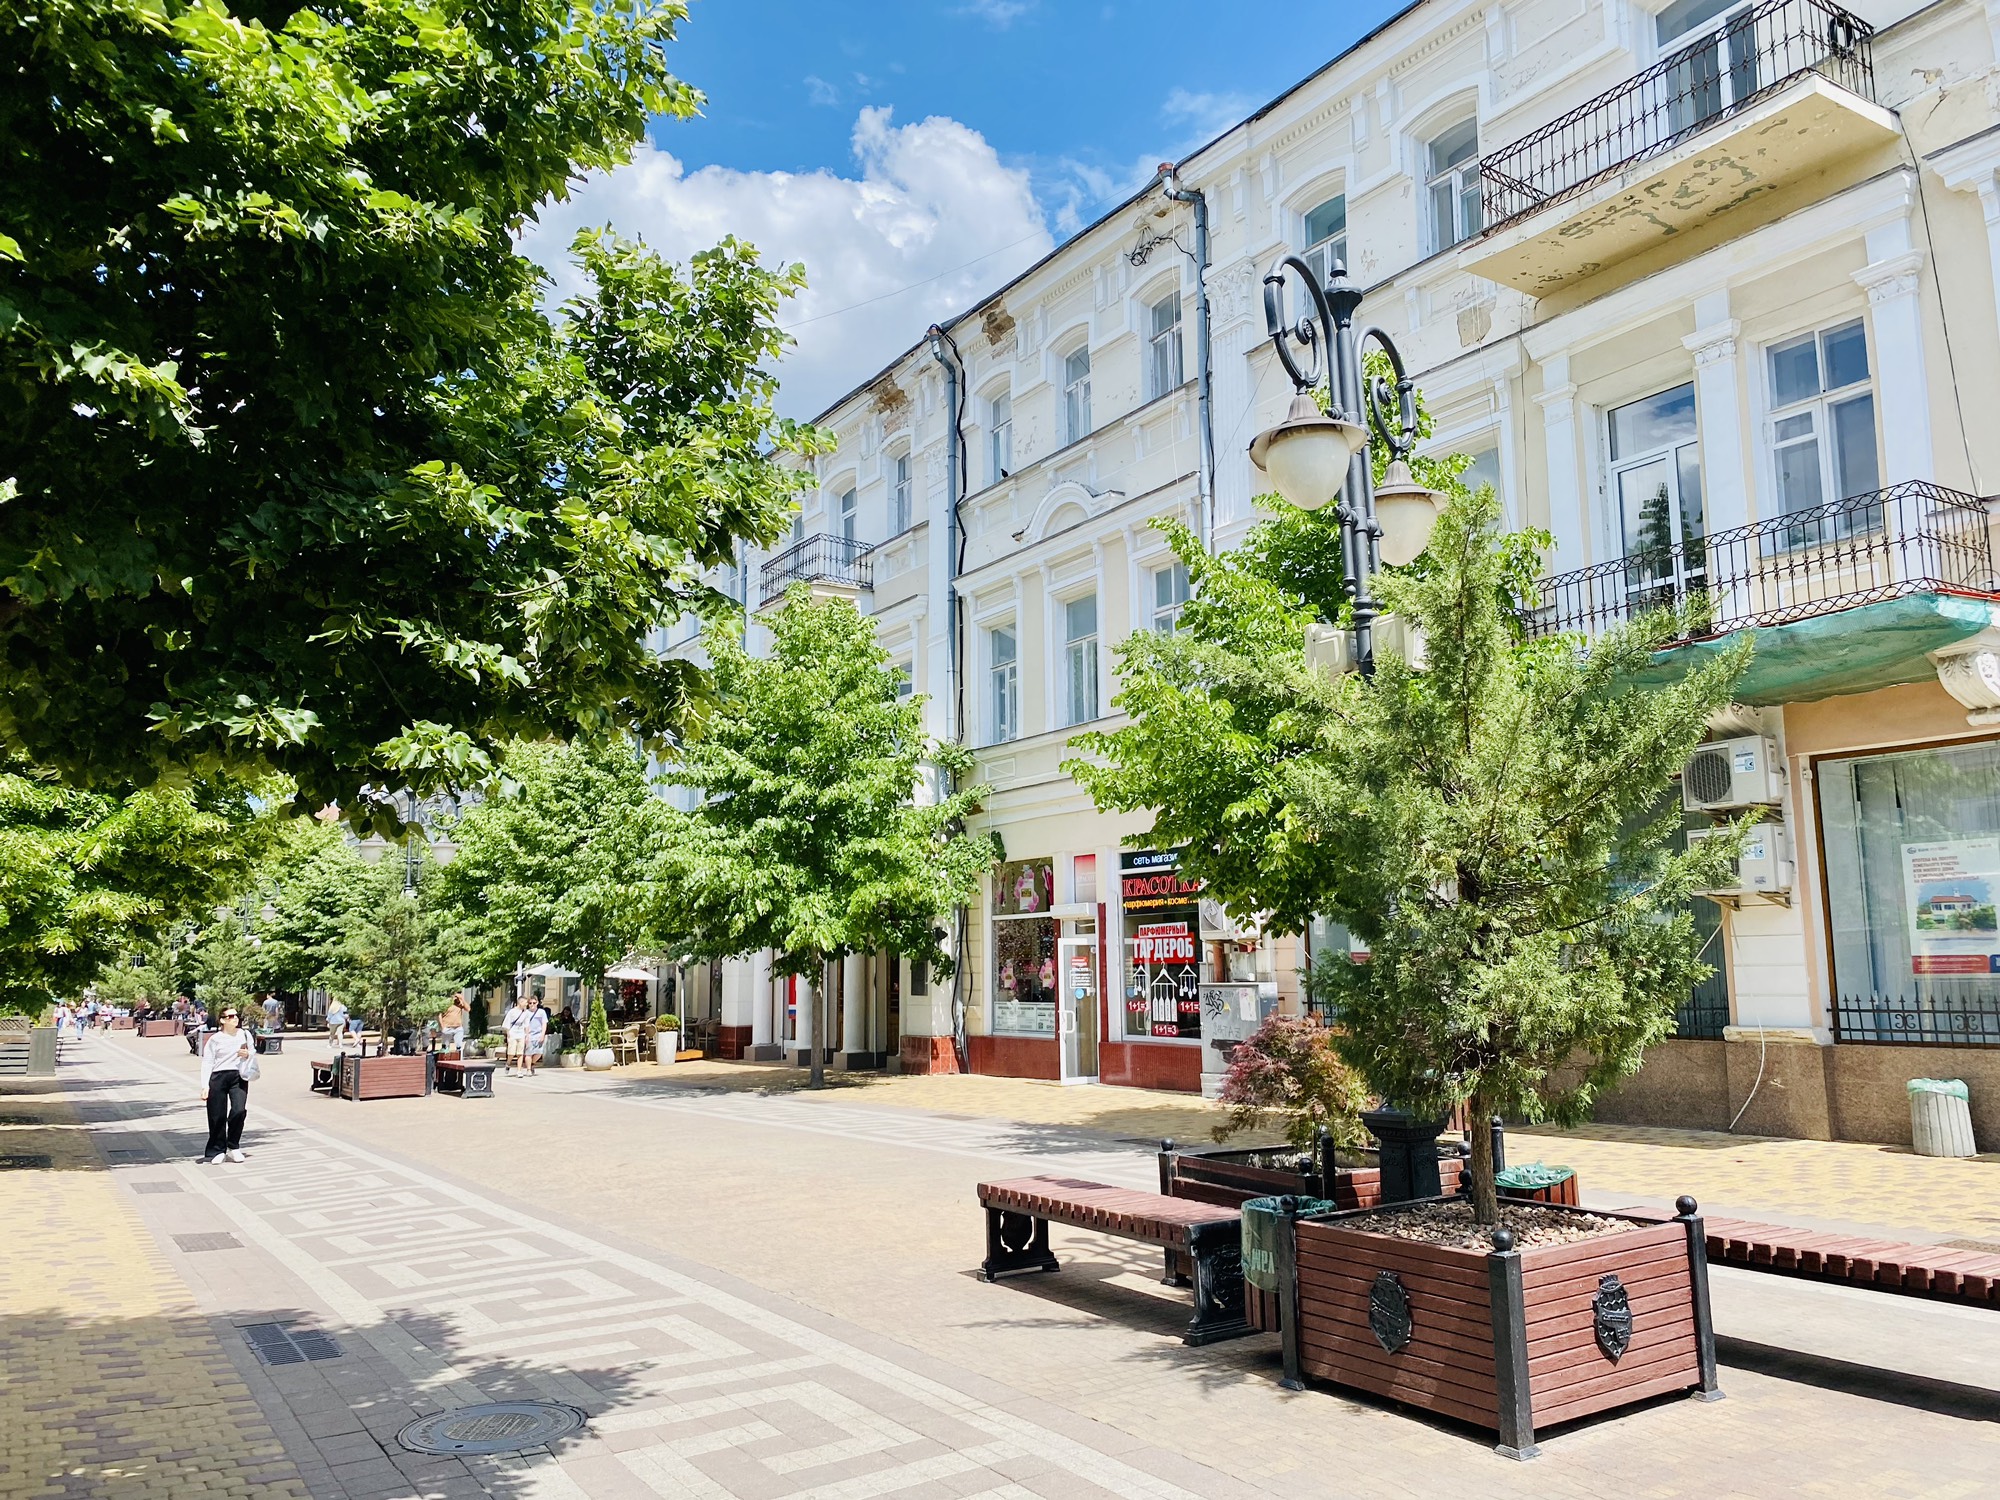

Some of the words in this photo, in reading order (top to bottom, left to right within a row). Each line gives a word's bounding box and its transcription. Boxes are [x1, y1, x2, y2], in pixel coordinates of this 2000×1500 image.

[1133, 857, 1150, 865] сеть
[1139, 923, 1186, 936] ПАРФЮМЕРНЫЙ
[1133, 937, 1194, 961] ГАРДЕРОБ
[1154, 1024, 1177, 1035] 1+1=3
